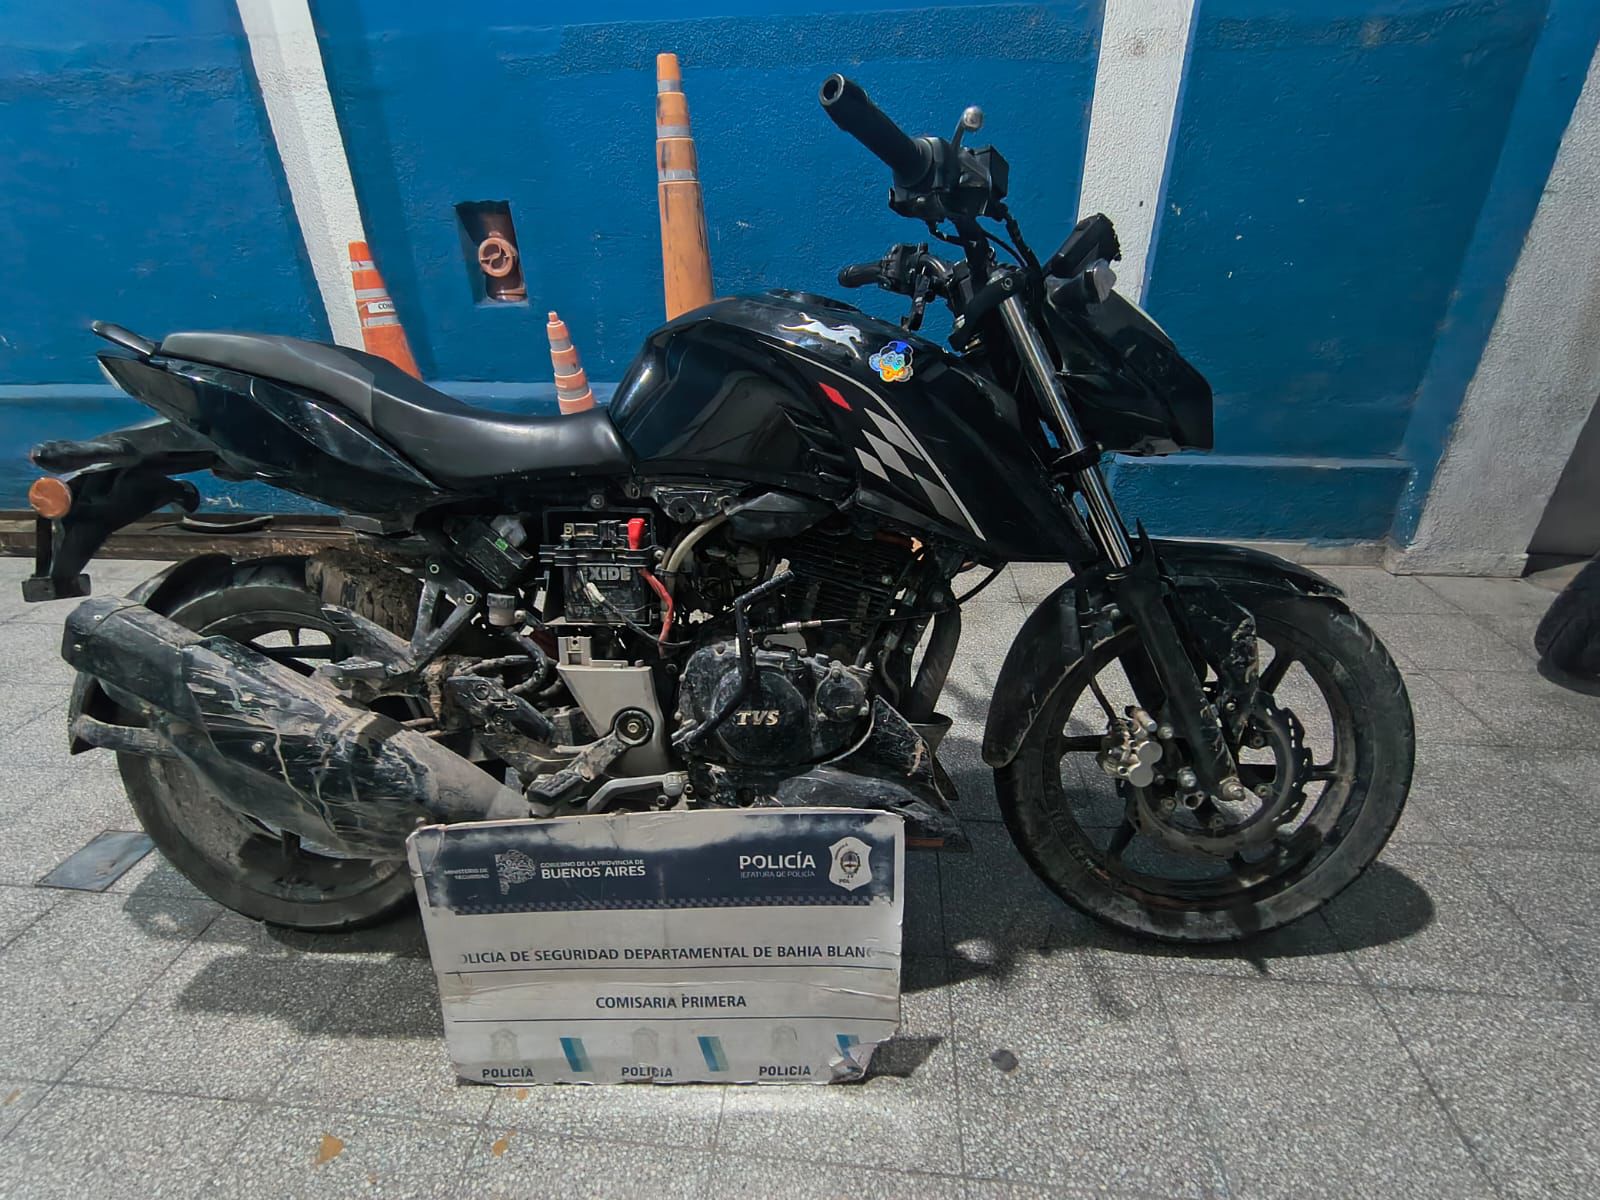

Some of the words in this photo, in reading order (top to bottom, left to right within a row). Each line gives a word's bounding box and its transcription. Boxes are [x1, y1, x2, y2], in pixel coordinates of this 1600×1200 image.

[735, 710, 779, 726] TVS
[739, 851, 817, 869] POLICÍA
[541, 867, 601, 879] BUENOS
[604, 866, 646, 877] AIRES
[511, 951, 530, 962] DE
[535, 949, 619, 961] SEGURIDAD
[624, 947, 749, 960] DEPARTAMENTAL
[753, 946, 772, 958] DE
[777, 946, 823, 958] BAHIA
[595, 996, 677, 1009] COMISARIA
[681, 995, 747, 1008] PRIMERA
[482, 1068, 534, 1078] POLICIA
[621, 1066, 673, 1078] POLICIA
[759, 1065, 811, 1076] POLICIA
